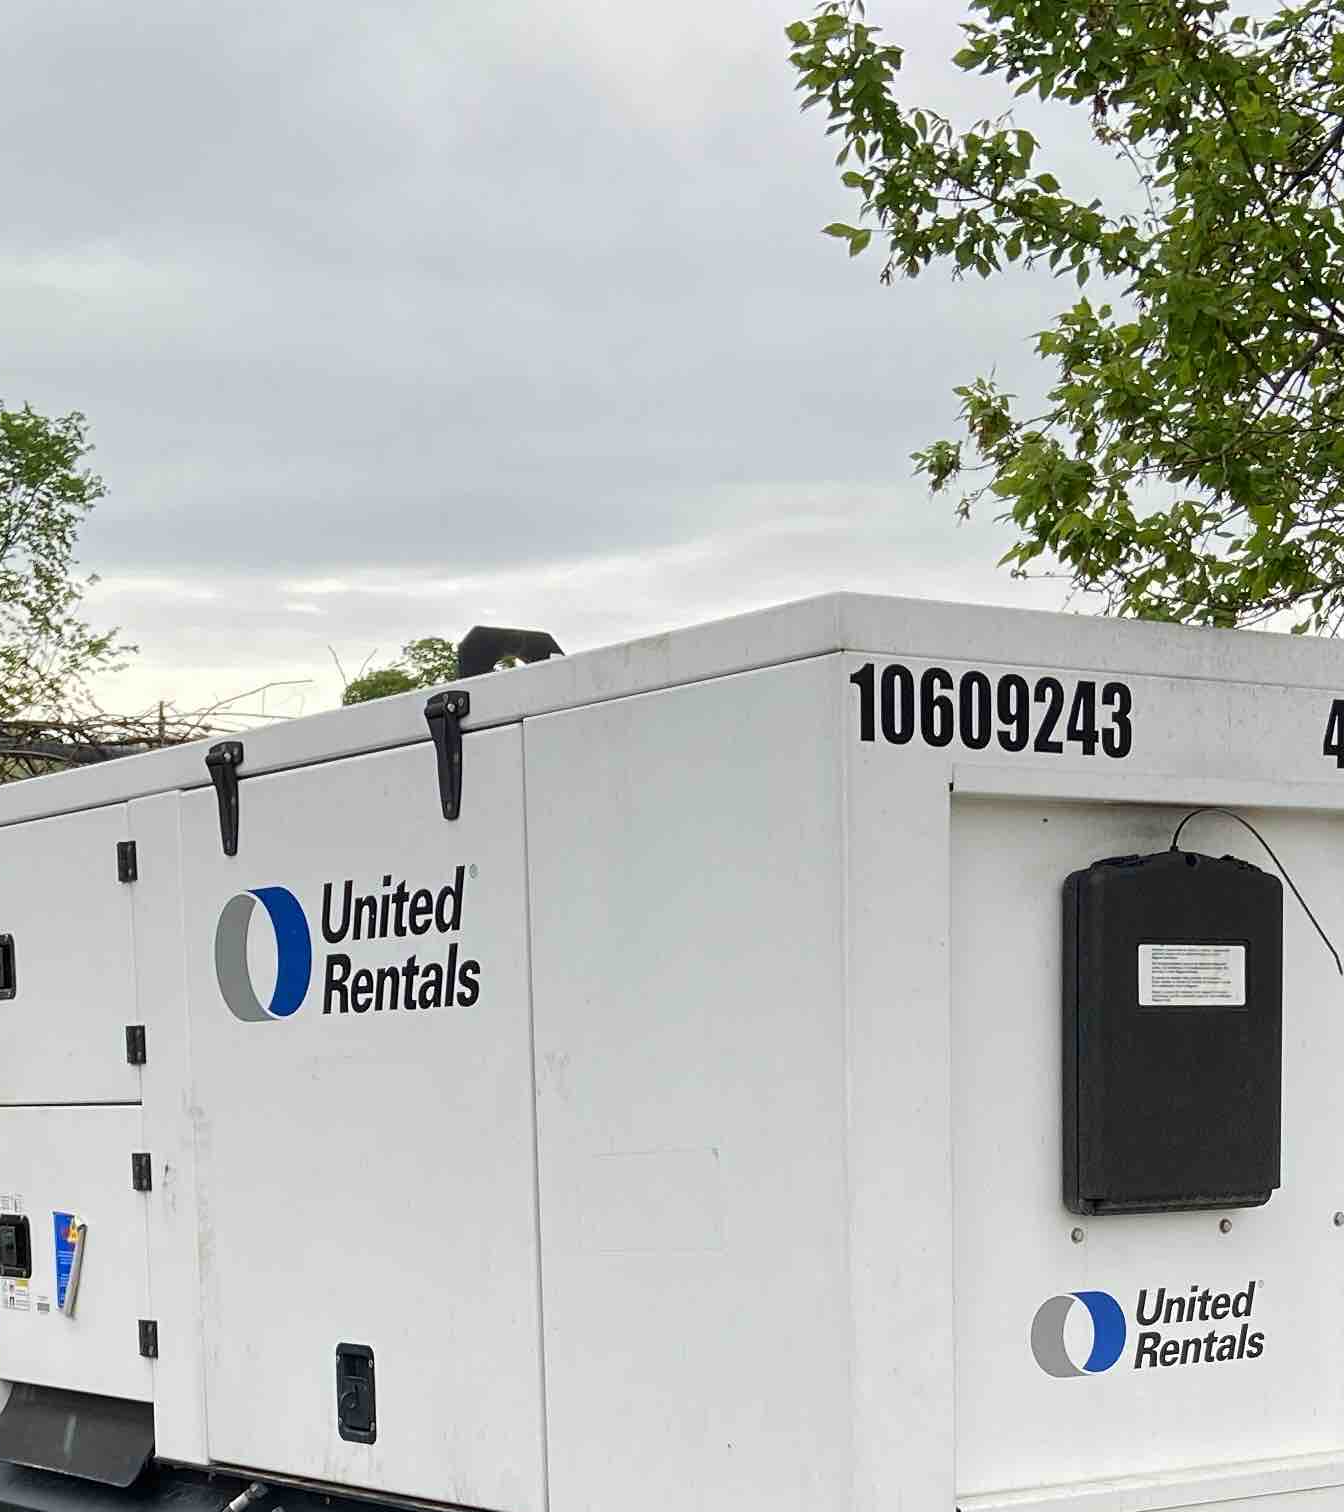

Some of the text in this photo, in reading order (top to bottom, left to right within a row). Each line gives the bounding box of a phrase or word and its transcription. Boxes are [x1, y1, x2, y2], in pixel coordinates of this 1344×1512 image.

[849, 662, 1132, 759] 10609243
[321, 865, 466, 944] United
[322, 942, 481, 1015] Rentals
[1136, 1280, 1256, 1326] United
[1134, 1323, 1265, 1369] Rentals
